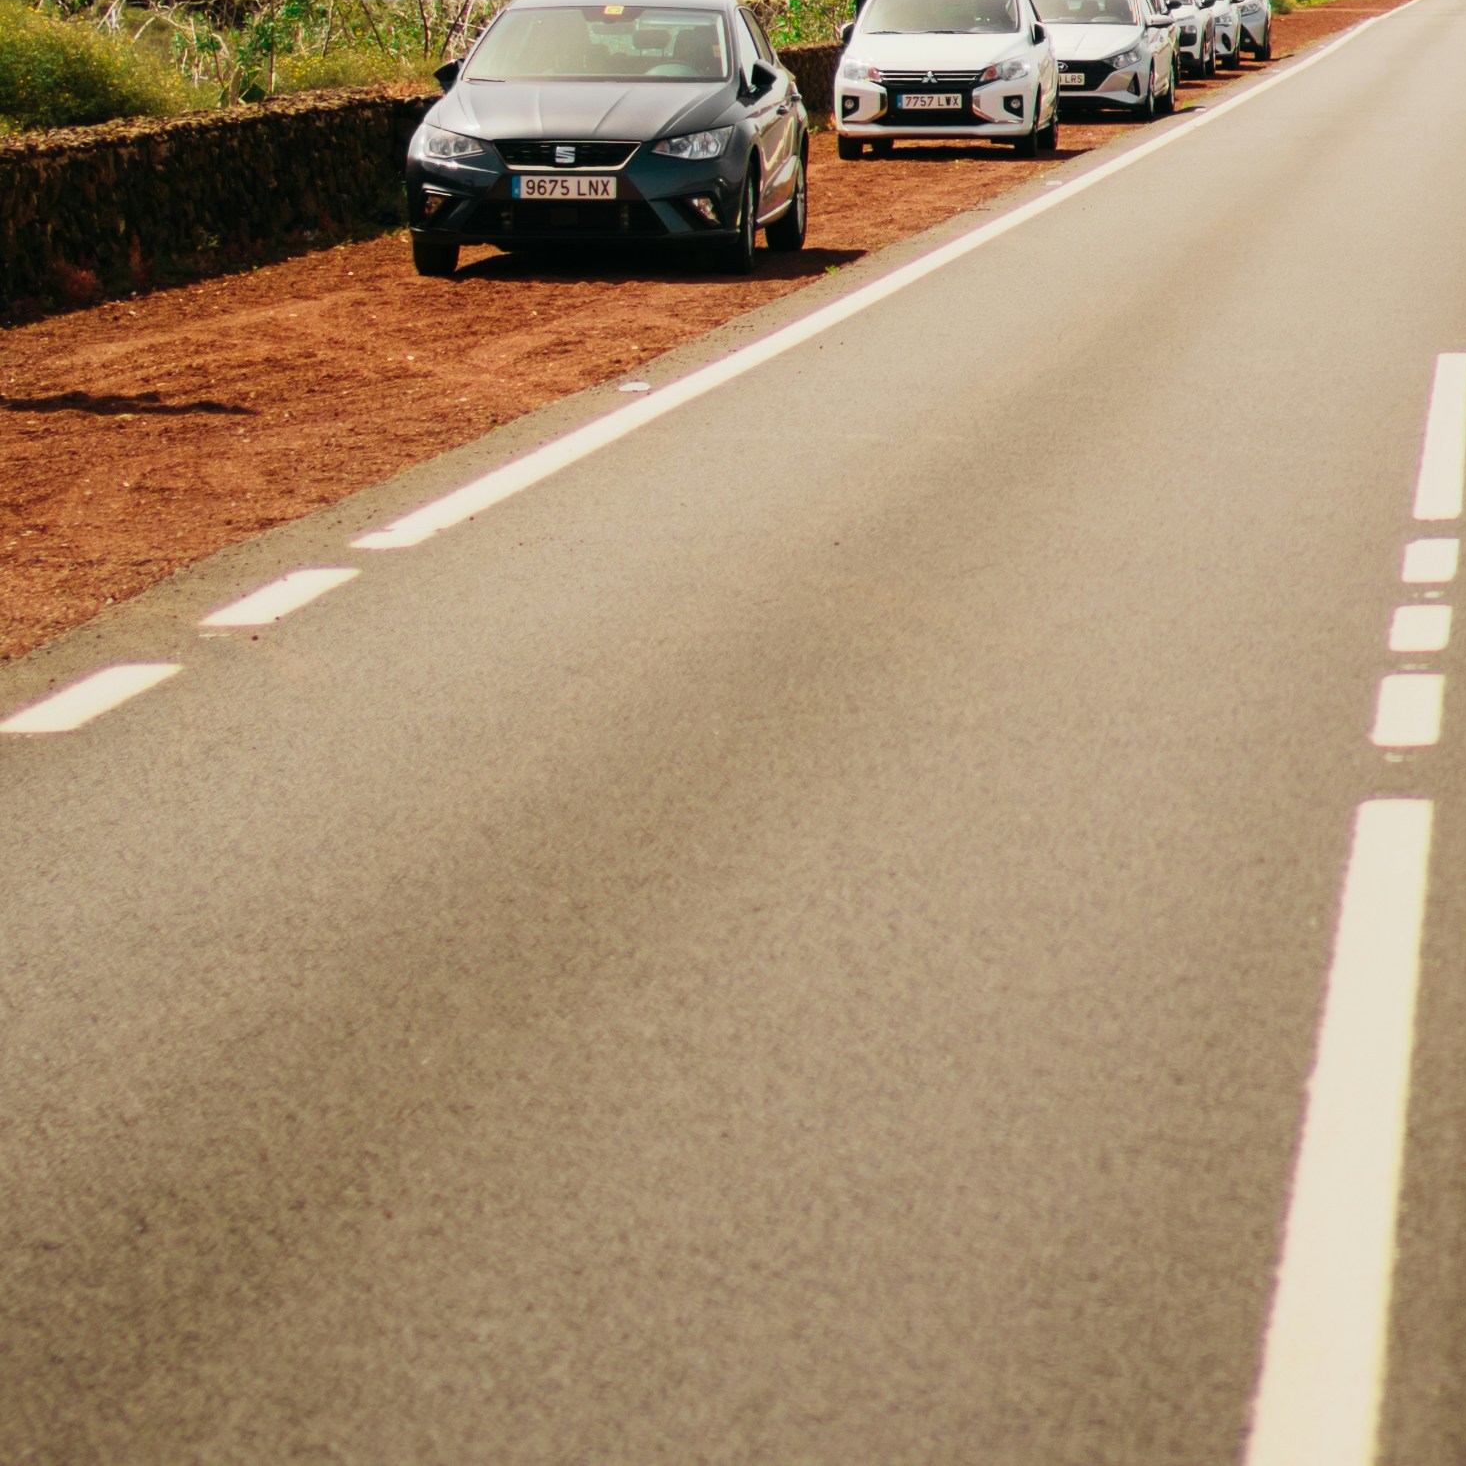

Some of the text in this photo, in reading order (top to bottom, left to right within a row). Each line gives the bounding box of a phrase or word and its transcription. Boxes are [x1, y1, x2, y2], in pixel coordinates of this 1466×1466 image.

[1065, 74, 1083, 84] LRS
[905, 96, 959, 107] 7757 LWX
[526, 179, 610, 197] 9675 LNX
